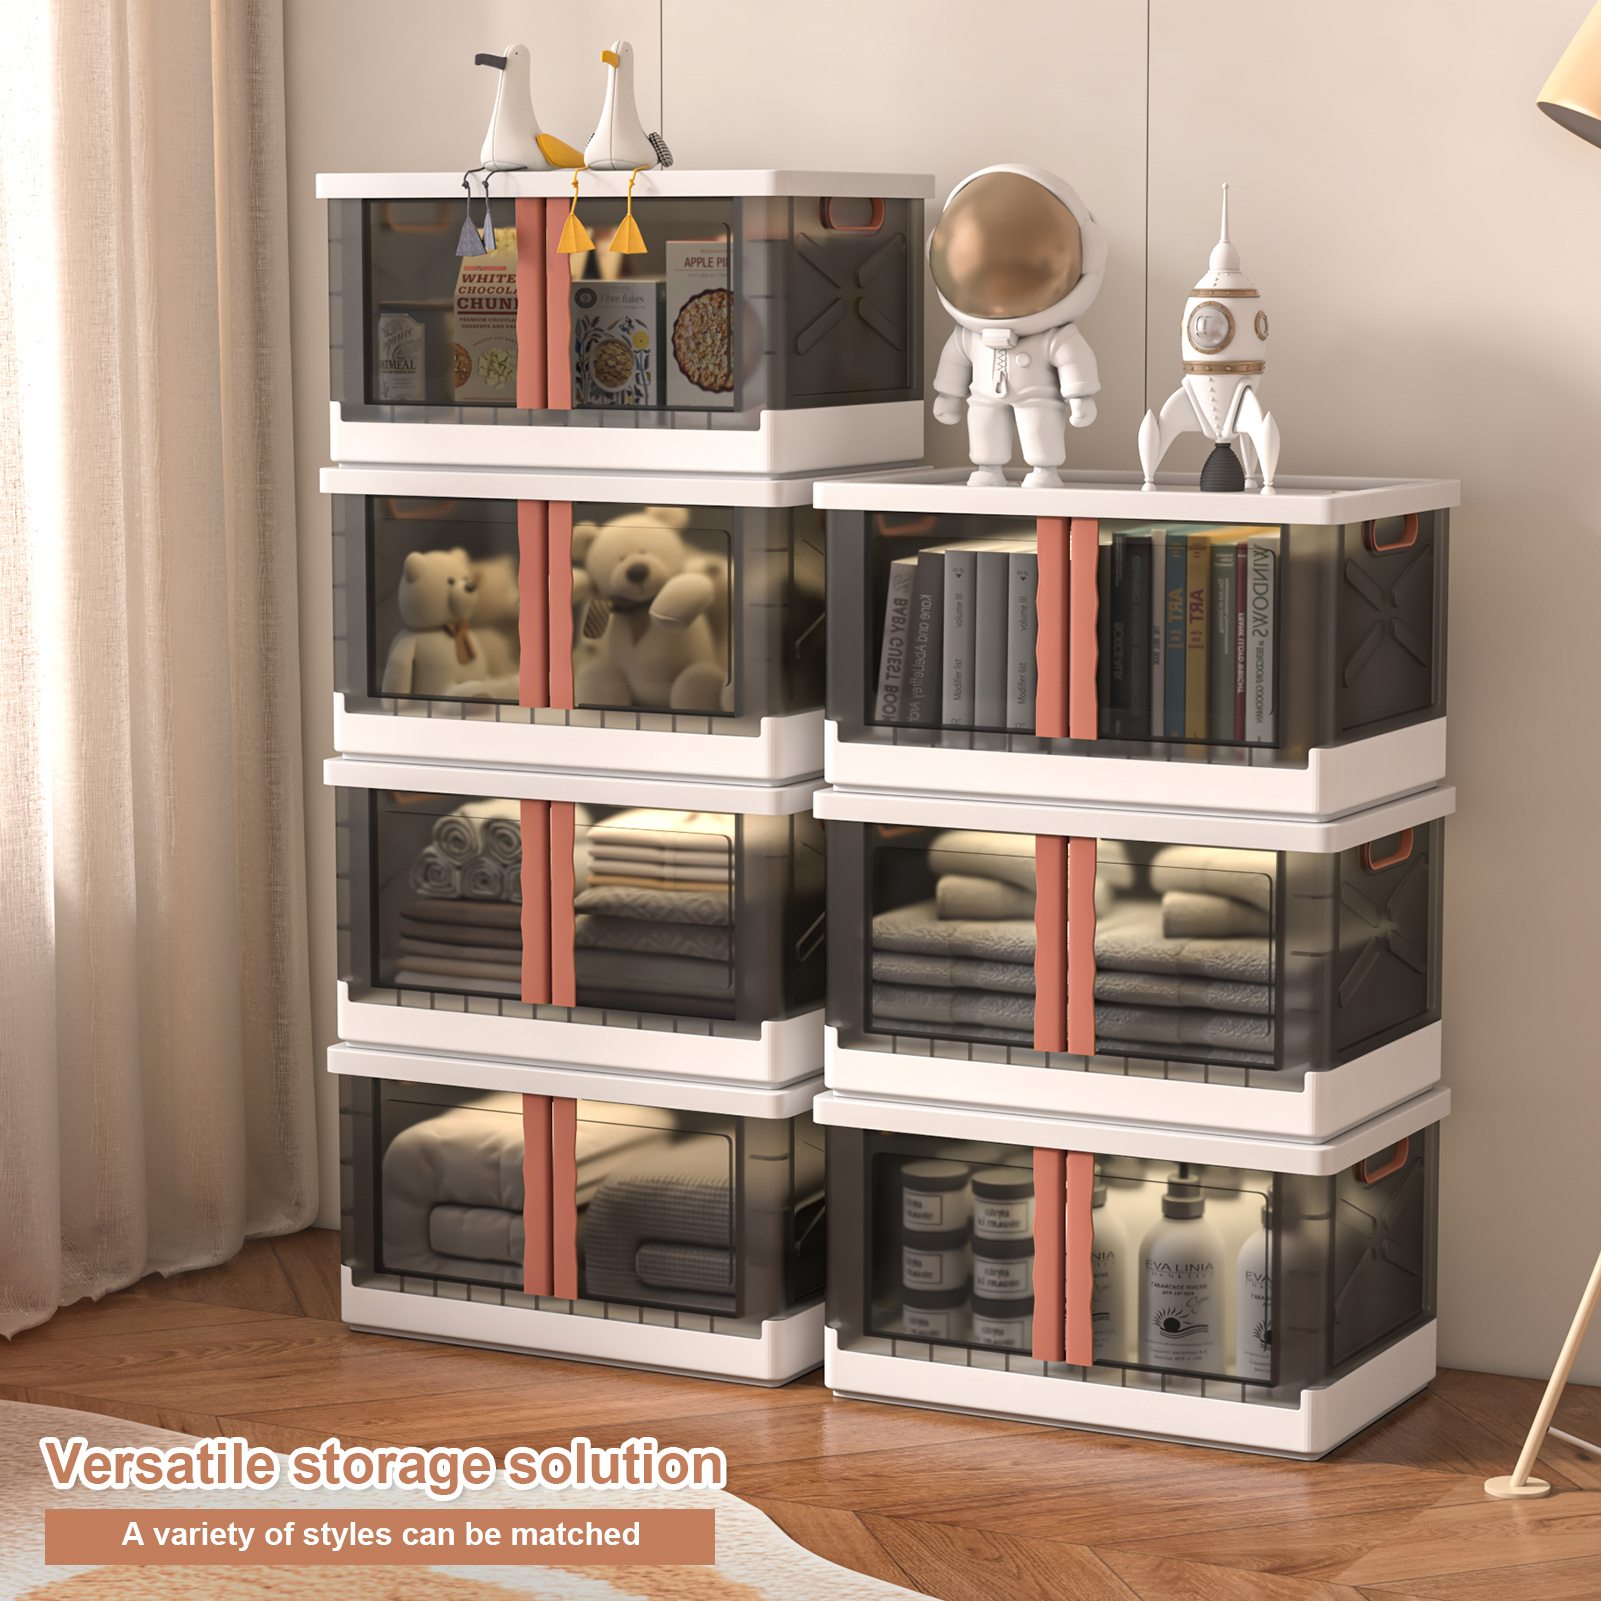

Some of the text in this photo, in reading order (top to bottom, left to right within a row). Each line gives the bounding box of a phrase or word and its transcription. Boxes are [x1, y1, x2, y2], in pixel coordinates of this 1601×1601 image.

[684, 257, 714, 268] APPLE
[461, 274, 517, 284] WHITE
[600, 292, 645, 303] Fibre flakes
[955, 602, 963, 628] volume
[1019, 604, 1028, 631] volume
[954, 658, 963, 671] list
[1018, 662, 1027, 675] list
[953, 672, 963, 701] Modifier
[1017, 675, 1027, 705] Modifier
[1092, 1251, 1115, 1260] NIA
[1145, 1259, 1214, 1272] EVA LINIA
